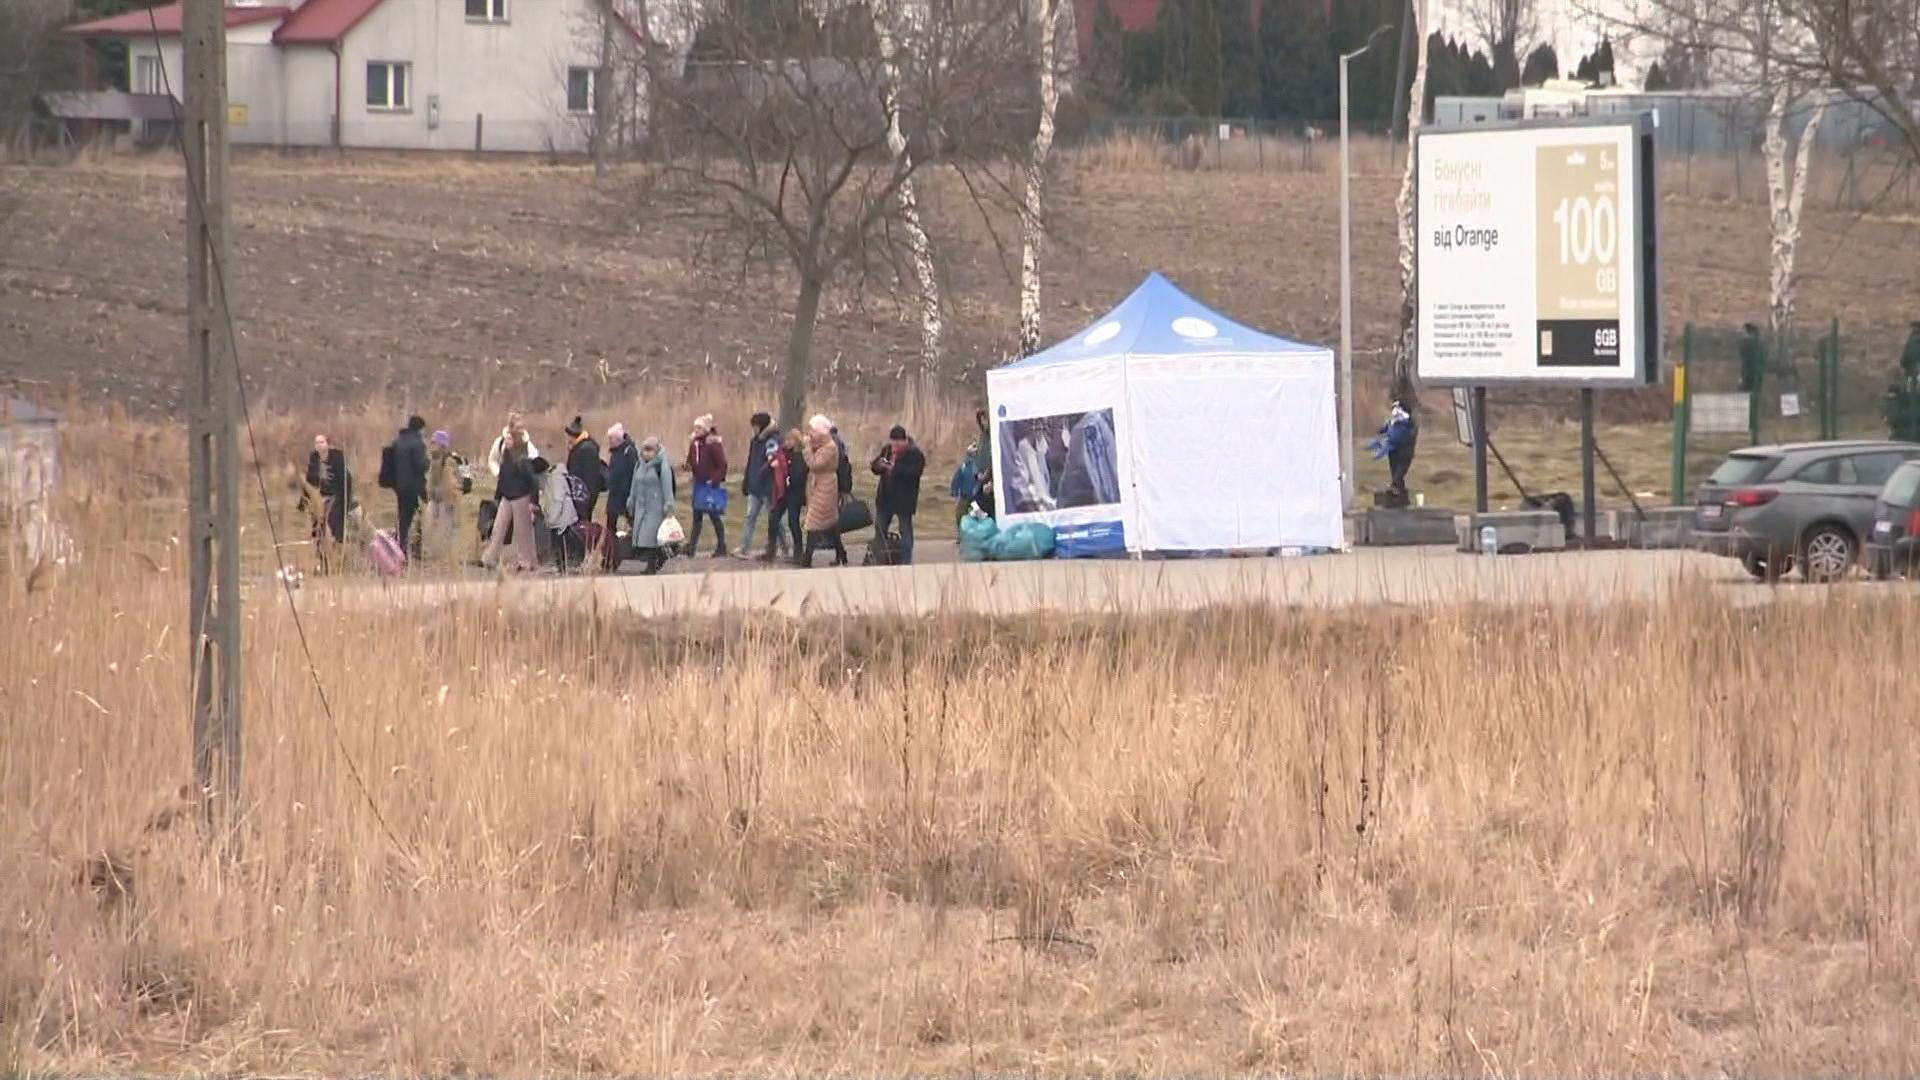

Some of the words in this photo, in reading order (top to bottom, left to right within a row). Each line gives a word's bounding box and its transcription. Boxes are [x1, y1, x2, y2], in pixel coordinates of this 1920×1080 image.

[1434, 158, 1482, 184] Бонусні
[1434, 225, 1452, 251] від
[1455, 224, 1498, 251] Orange
[1553, 196, 1616, 265] 100
[1596, 267, 1616, 293] GB
[1595, 328, 1617, 347] 6GB
